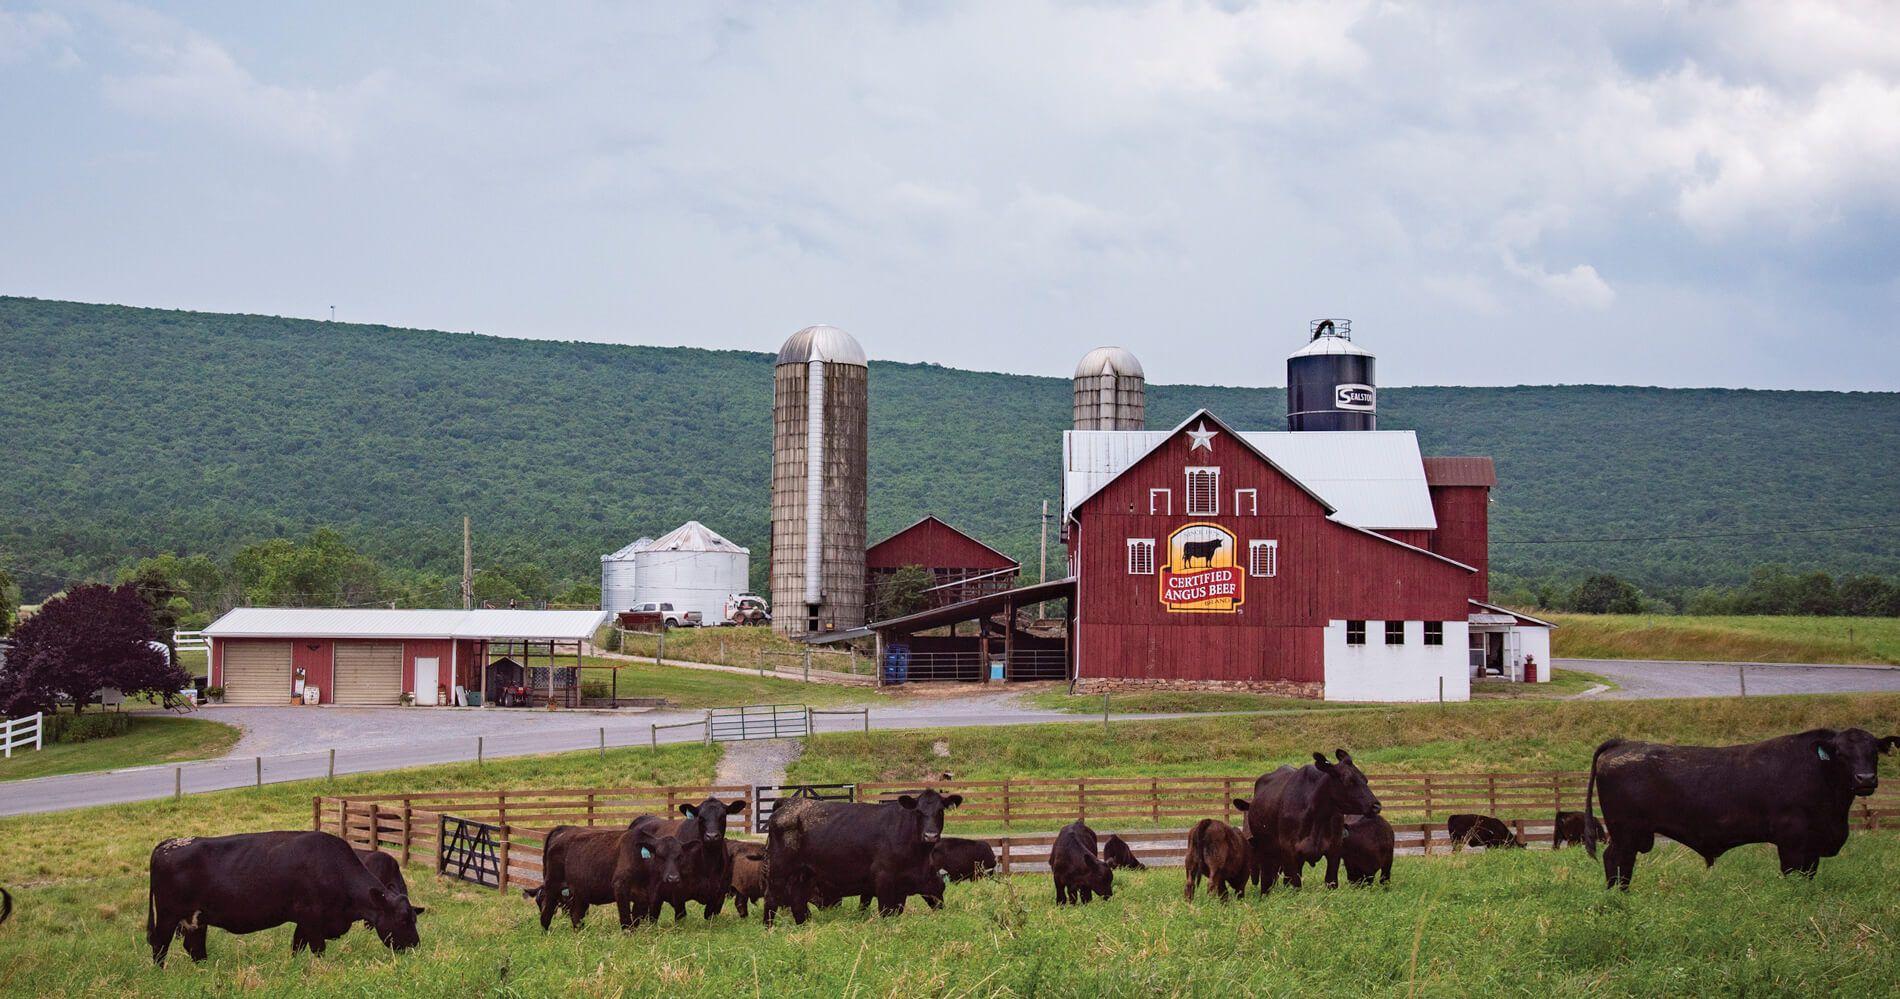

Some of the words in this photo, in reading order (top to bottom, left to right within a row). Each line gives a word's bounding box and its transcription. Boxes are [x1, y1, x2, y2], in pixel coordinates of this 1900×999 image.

[1169, 570, 1232, 588] CERTIFIED
[1165, 587, 1206, 600] ANGUS
[1209, 584, 1236, 596] BEEF
